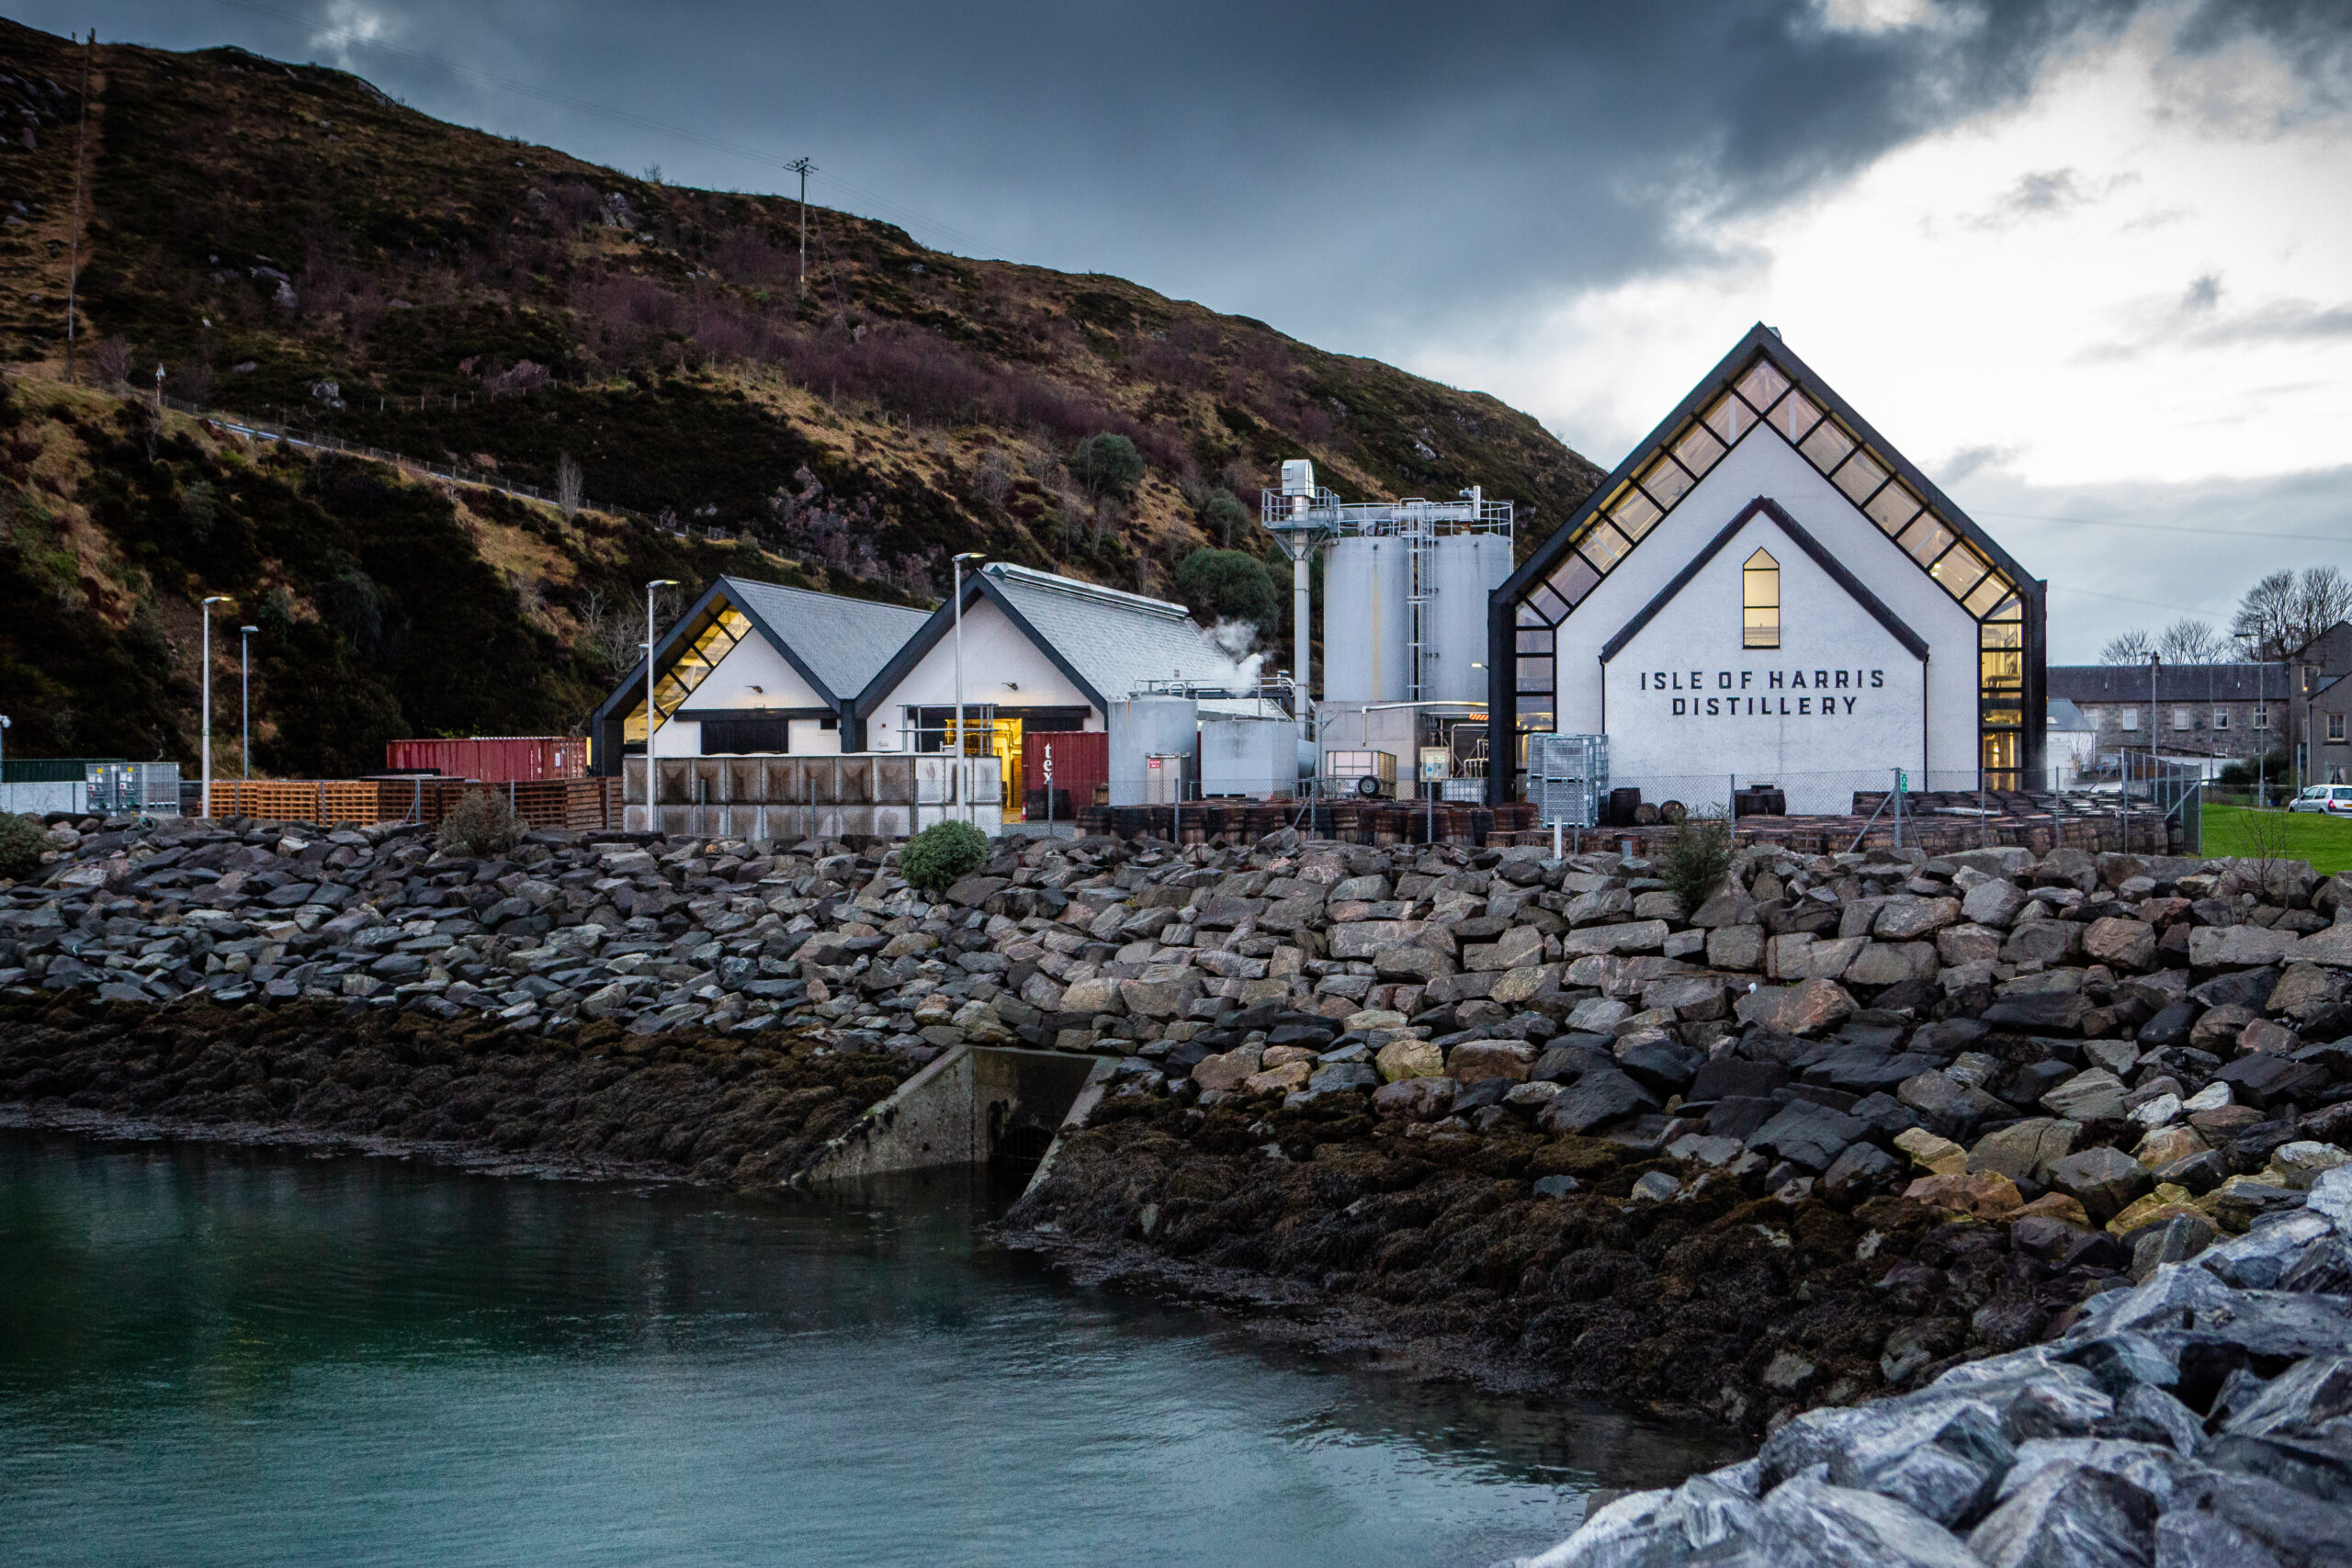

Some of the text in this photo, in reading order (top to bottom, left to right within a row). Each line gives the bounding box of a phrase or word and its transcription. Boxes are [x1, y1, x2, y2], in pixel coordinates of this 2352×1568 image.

[1641, 670, 1884, 690] ISLE OF HARRIS
[1672, 697, 1857, 716] DISTILLERY
